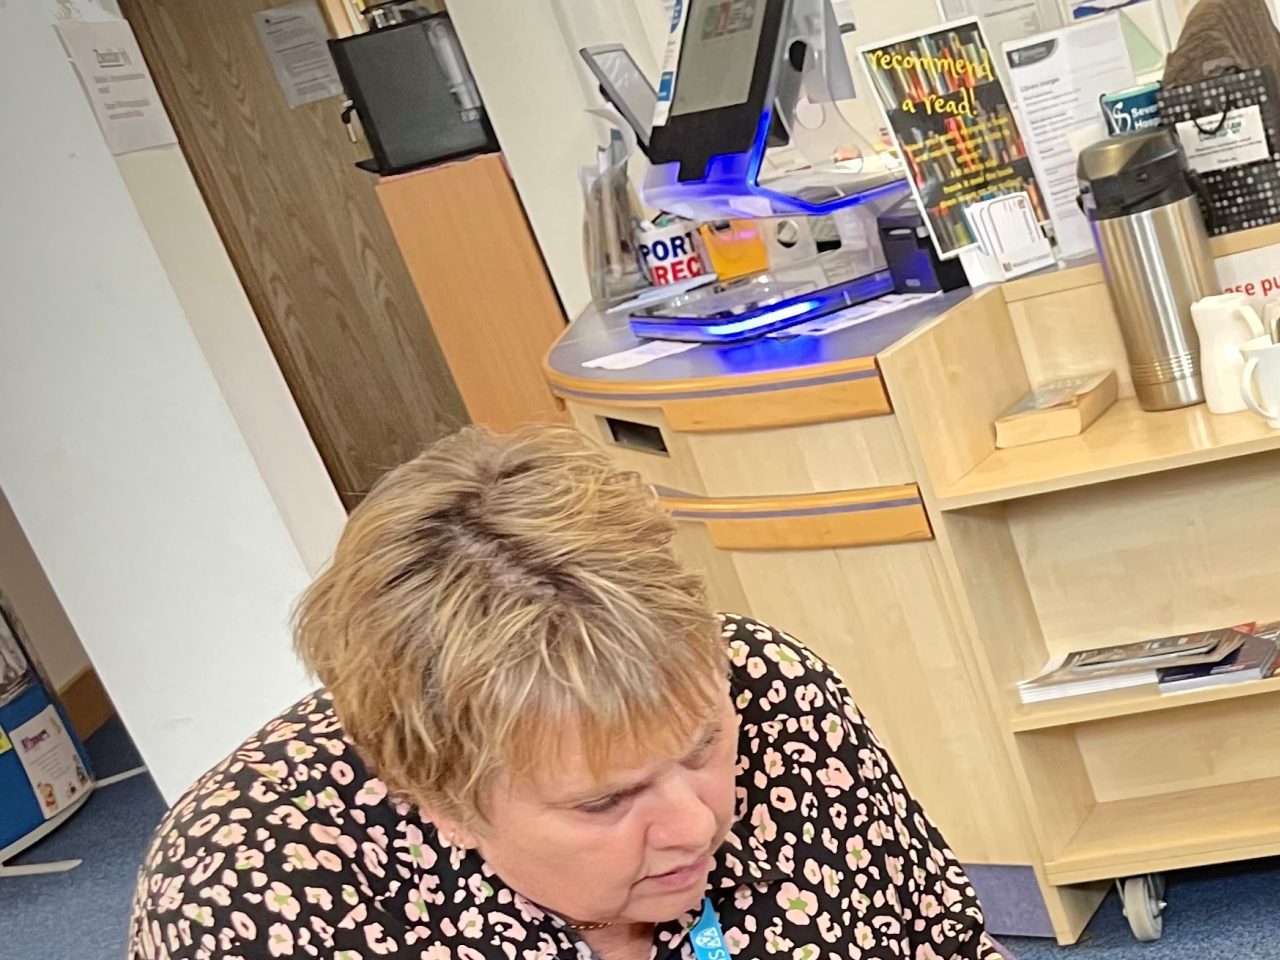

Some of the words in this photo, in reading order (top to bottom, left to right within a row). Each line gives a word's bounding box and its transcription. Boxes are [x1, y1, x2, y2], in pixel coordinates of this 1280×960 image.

[869, 48, 995, 87] recommend
[903, 101, 916, 114] a
[924, 87, 978, 119] read!
